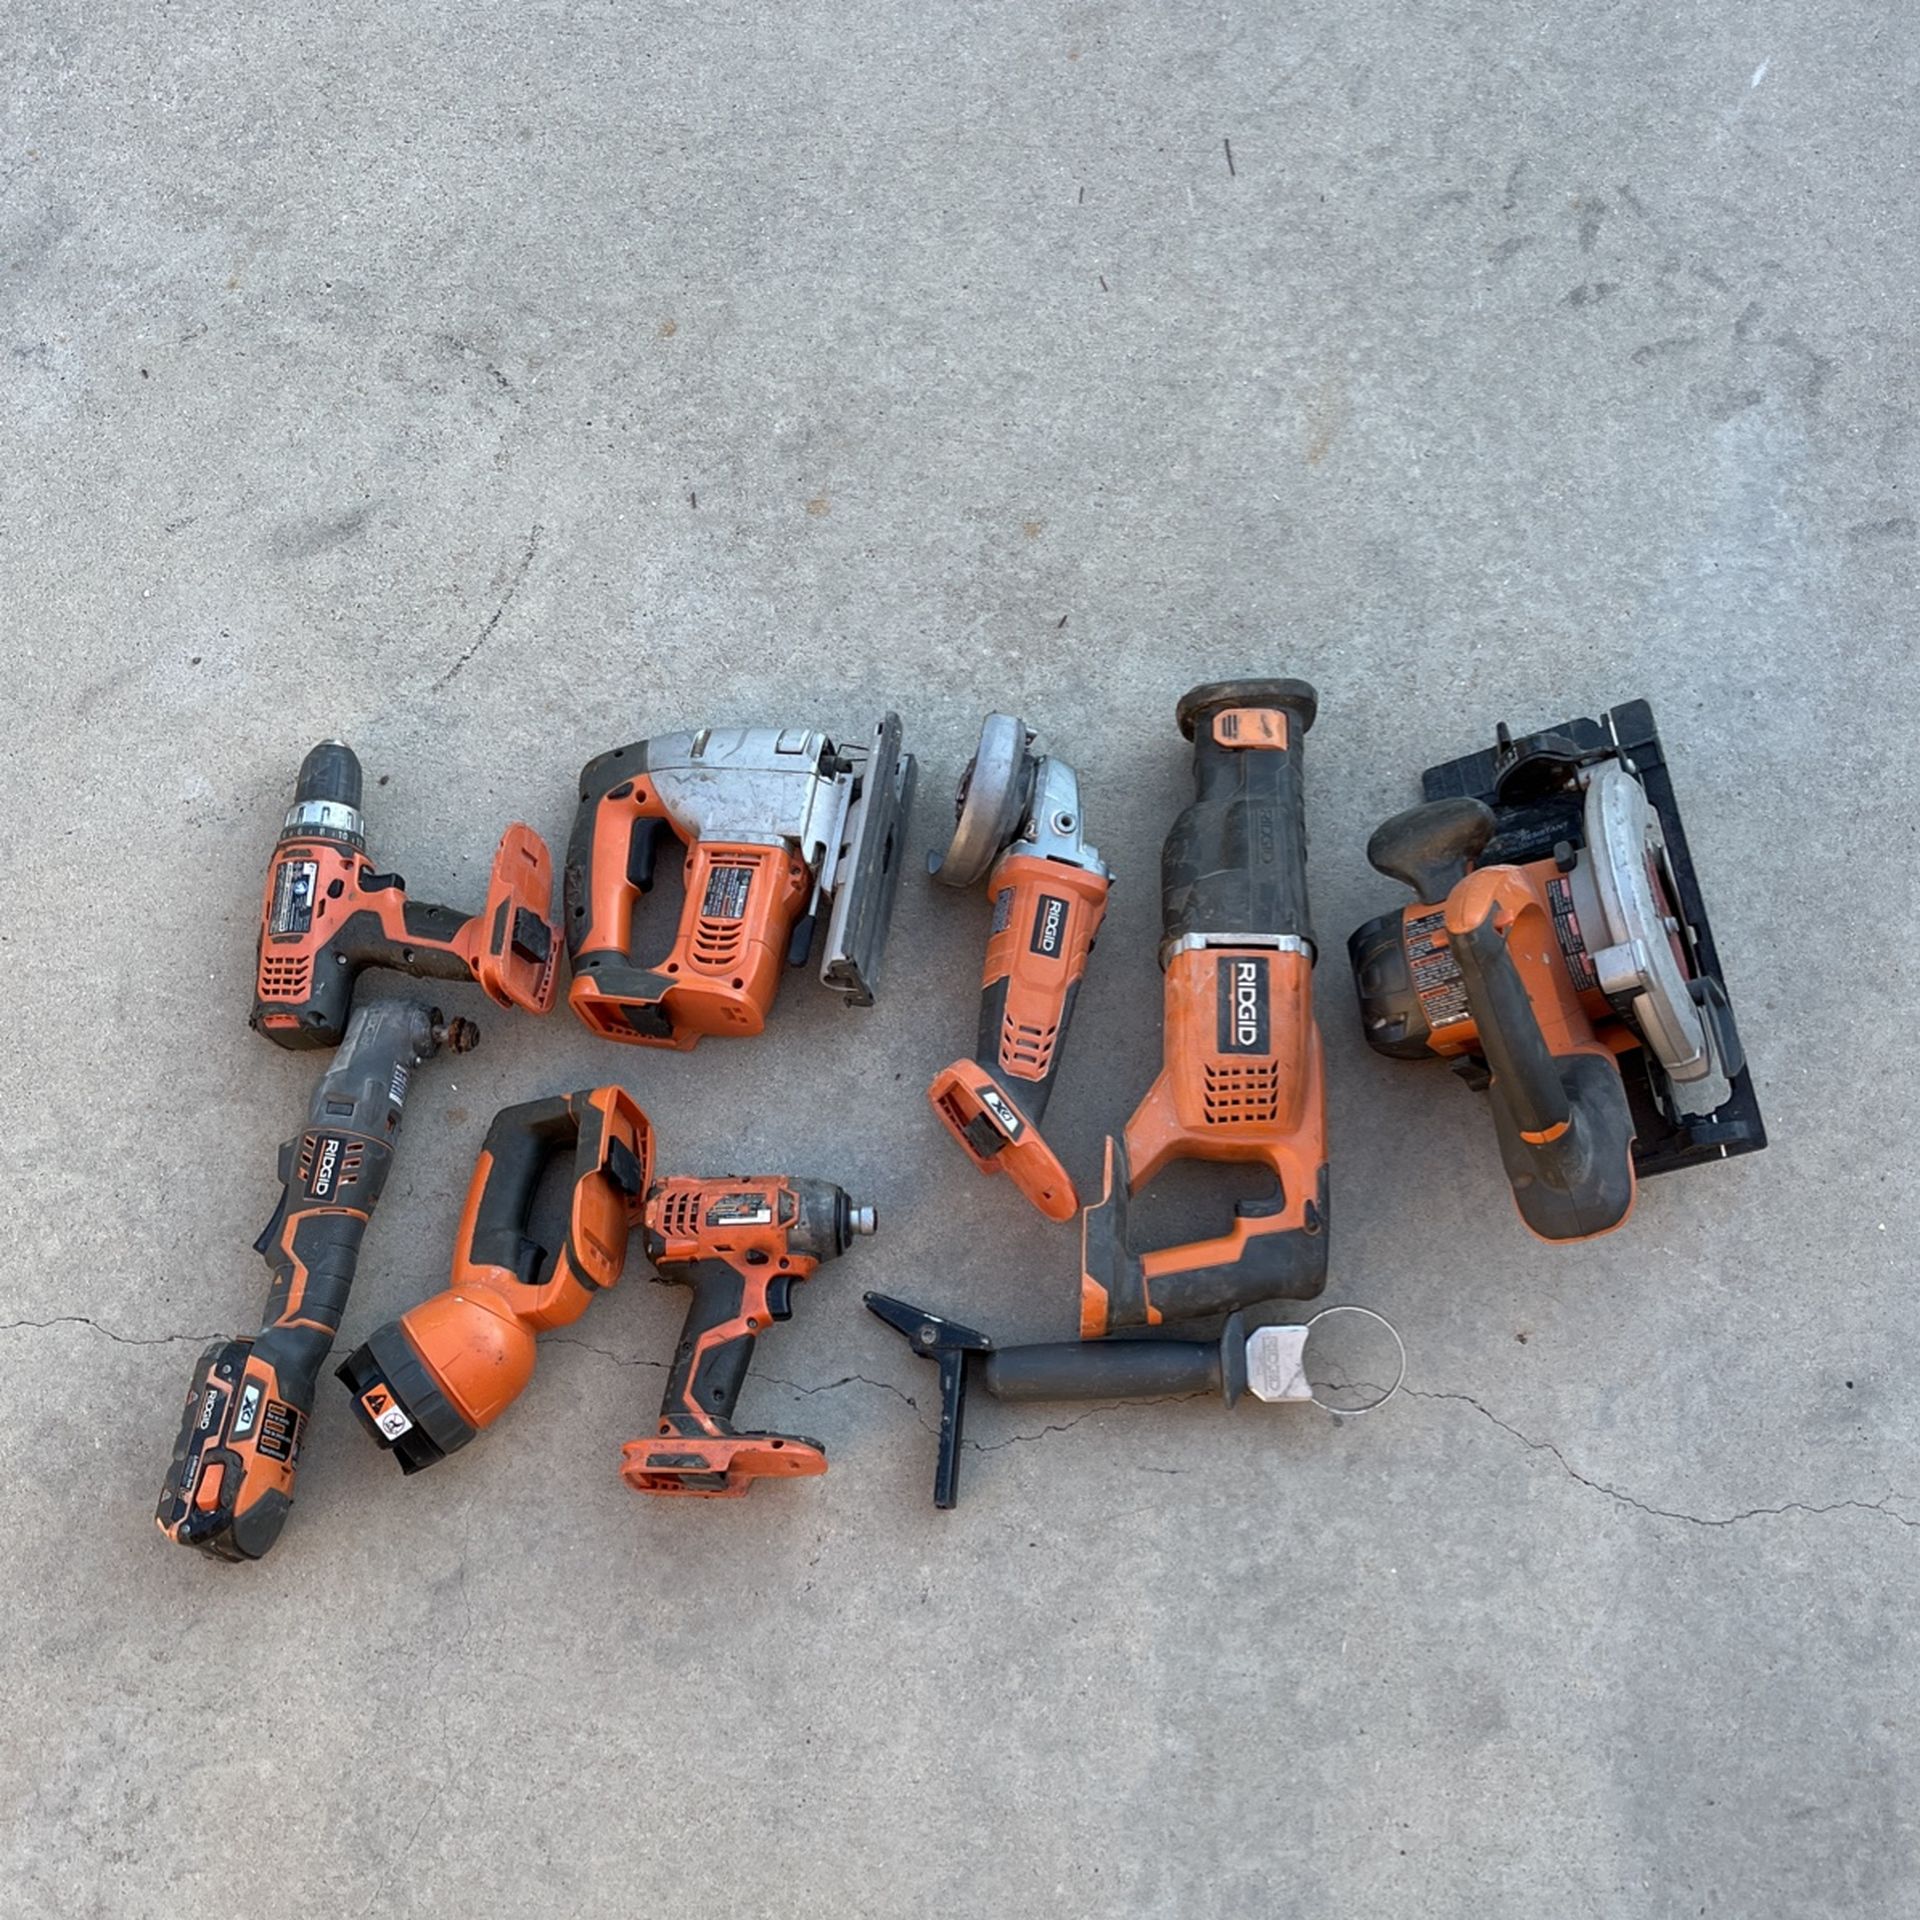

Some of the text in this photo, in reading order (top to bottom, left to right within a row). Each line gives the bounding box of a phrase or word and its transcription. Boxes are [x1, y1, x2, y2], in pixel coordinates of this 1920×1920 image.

[1042, 900, 1062, 952] RIDGID
[1237, 963, 1257, 1046] RIDGID
[316, 1139, 340, 1196] RIDGID
[200, 1390, 218, 1430] RIDGID
